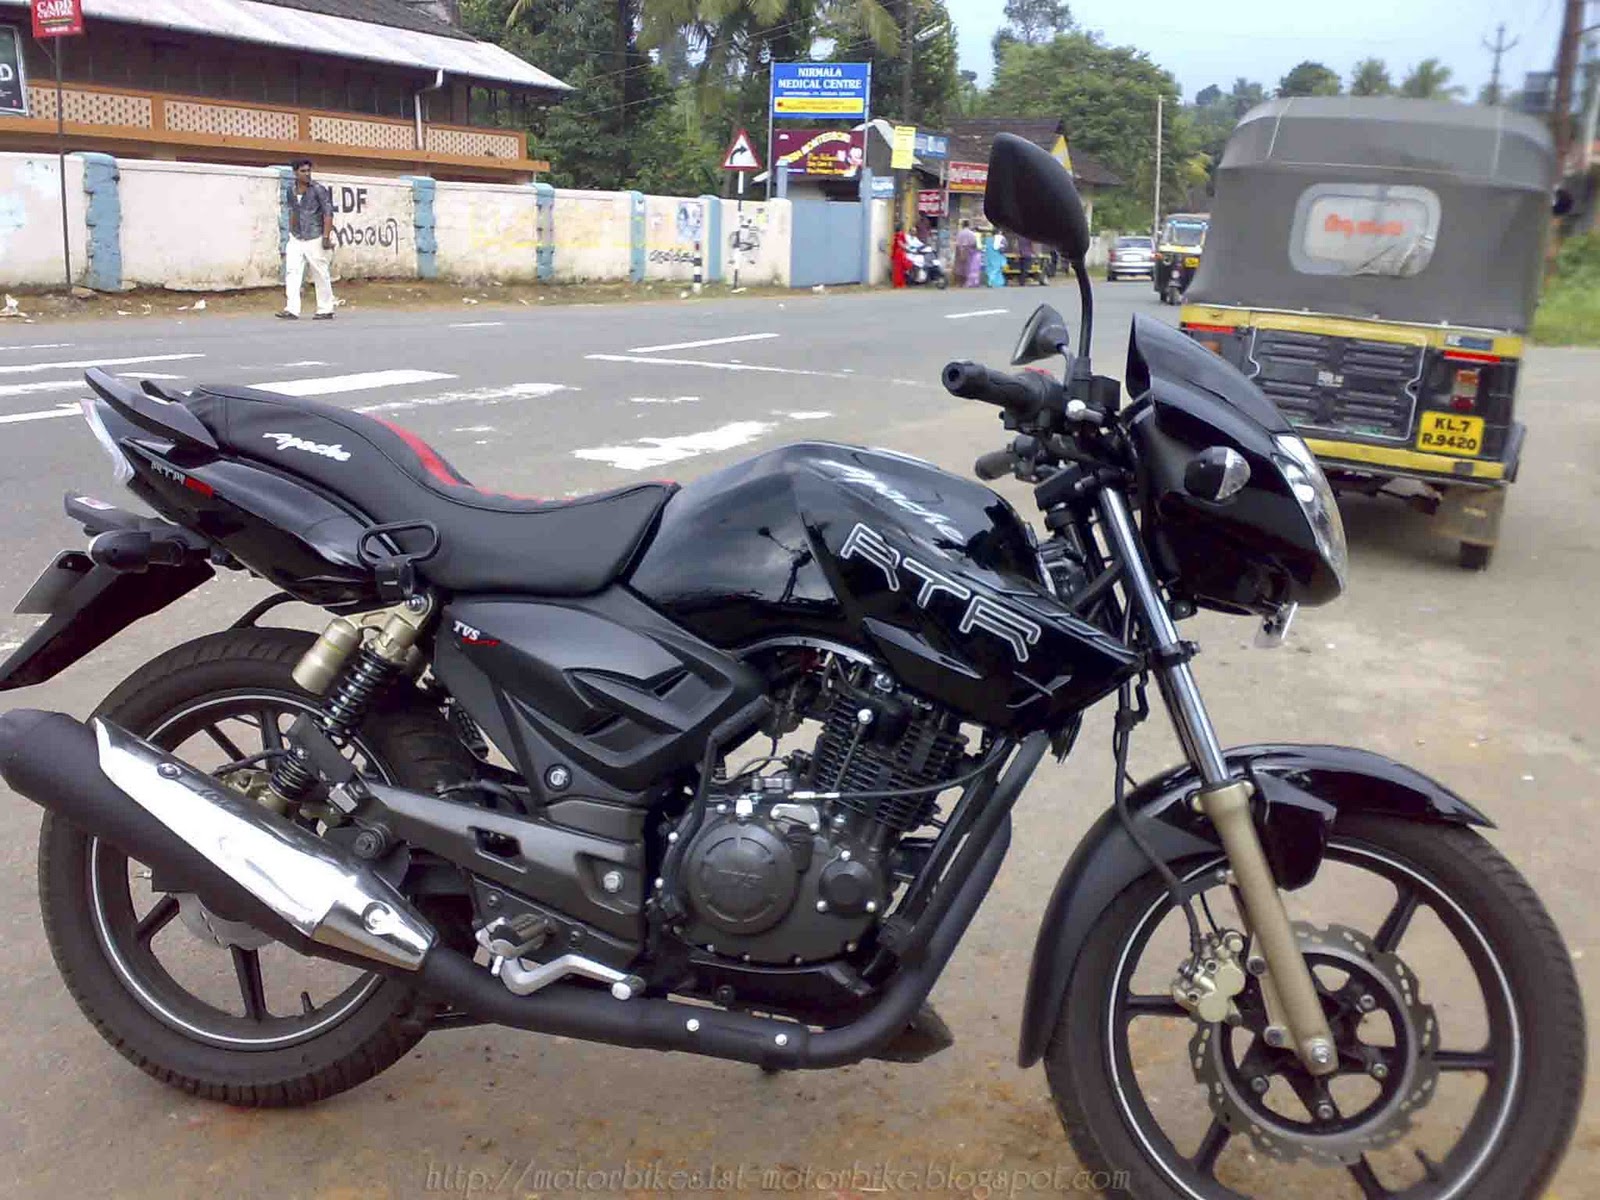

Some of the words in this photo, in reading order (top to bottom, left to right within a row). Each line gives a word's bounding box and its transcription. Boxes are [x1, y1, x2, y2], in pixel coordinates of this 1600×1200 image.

[778, 79, 822, 89] MEDICAL
[823, 79, 863, 89] CENTRE
[797, 67, 842, 77] NIRMALA
[328, 186, 367, 213] LDF
[262, 433, 351, 461] Apache
[840, 522, 1041, 662] RTR
[453, 620, 480, 641] TVS
